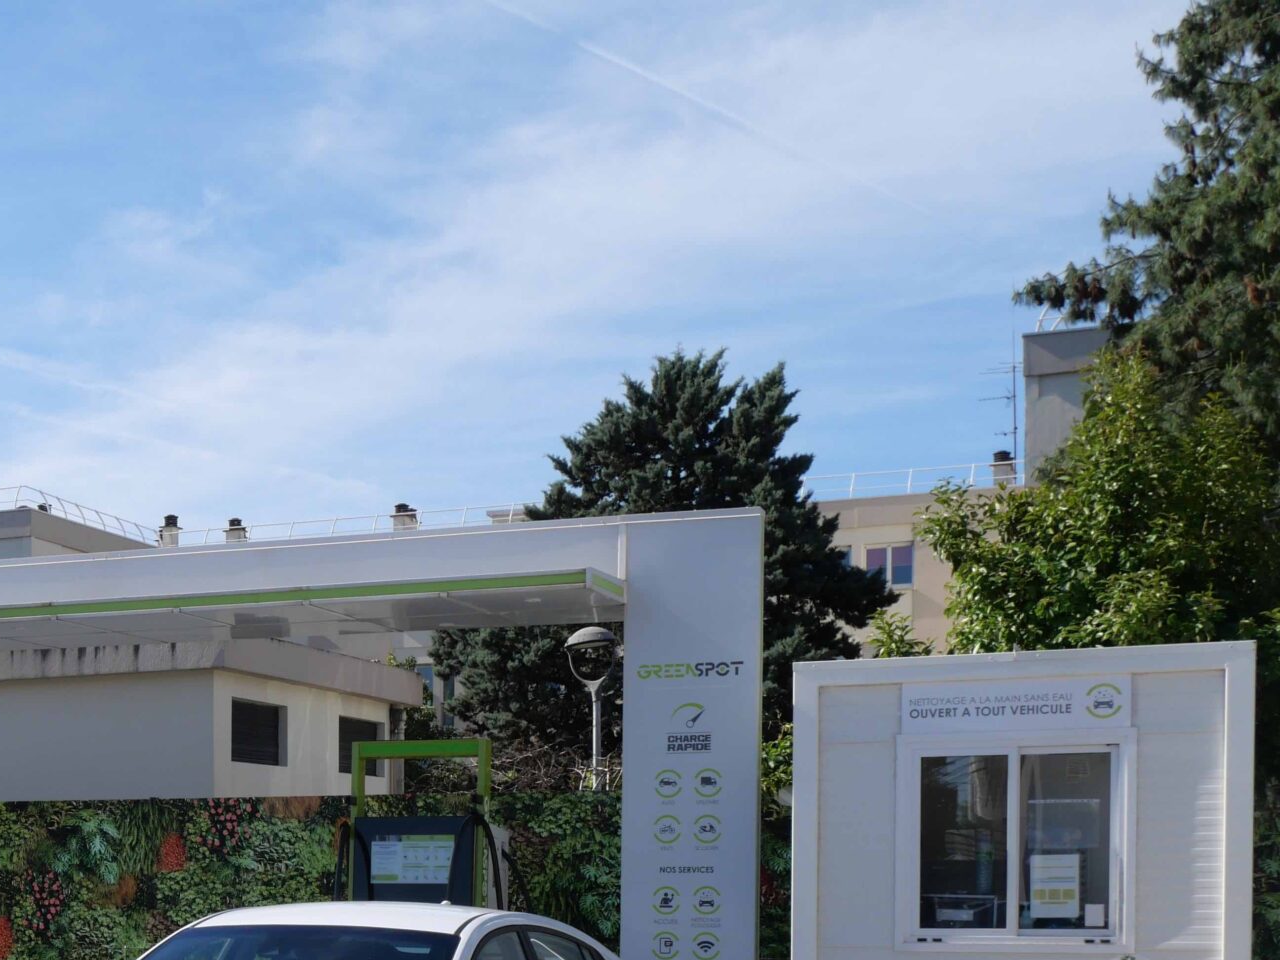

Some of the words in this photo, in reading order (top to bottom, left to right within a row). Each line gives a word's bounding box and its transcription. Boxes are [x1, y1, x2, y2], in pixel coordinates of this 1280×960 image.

[909, 695, 967, 706] NETTOYAGE
[970, 695, 978, 705] A
[980, 695, 991, 704] LA
[994, 694, 1021, 704] MAIN
[1024, 693, 1051, 703] SANS
[1053, 692, 1073, 702] EAU
[909, 707, 957, 719] OUVERT
[962, 707, 971, 717] A
[976, 705, 1006, 717] TOUT
[1010, 703, 1072, 716] VEHICULE
[668, 734, 712, 743] CHARGE
[668, 743, 712, 752] RAPIDE
[678, 866, 715, 874] SERVICES
